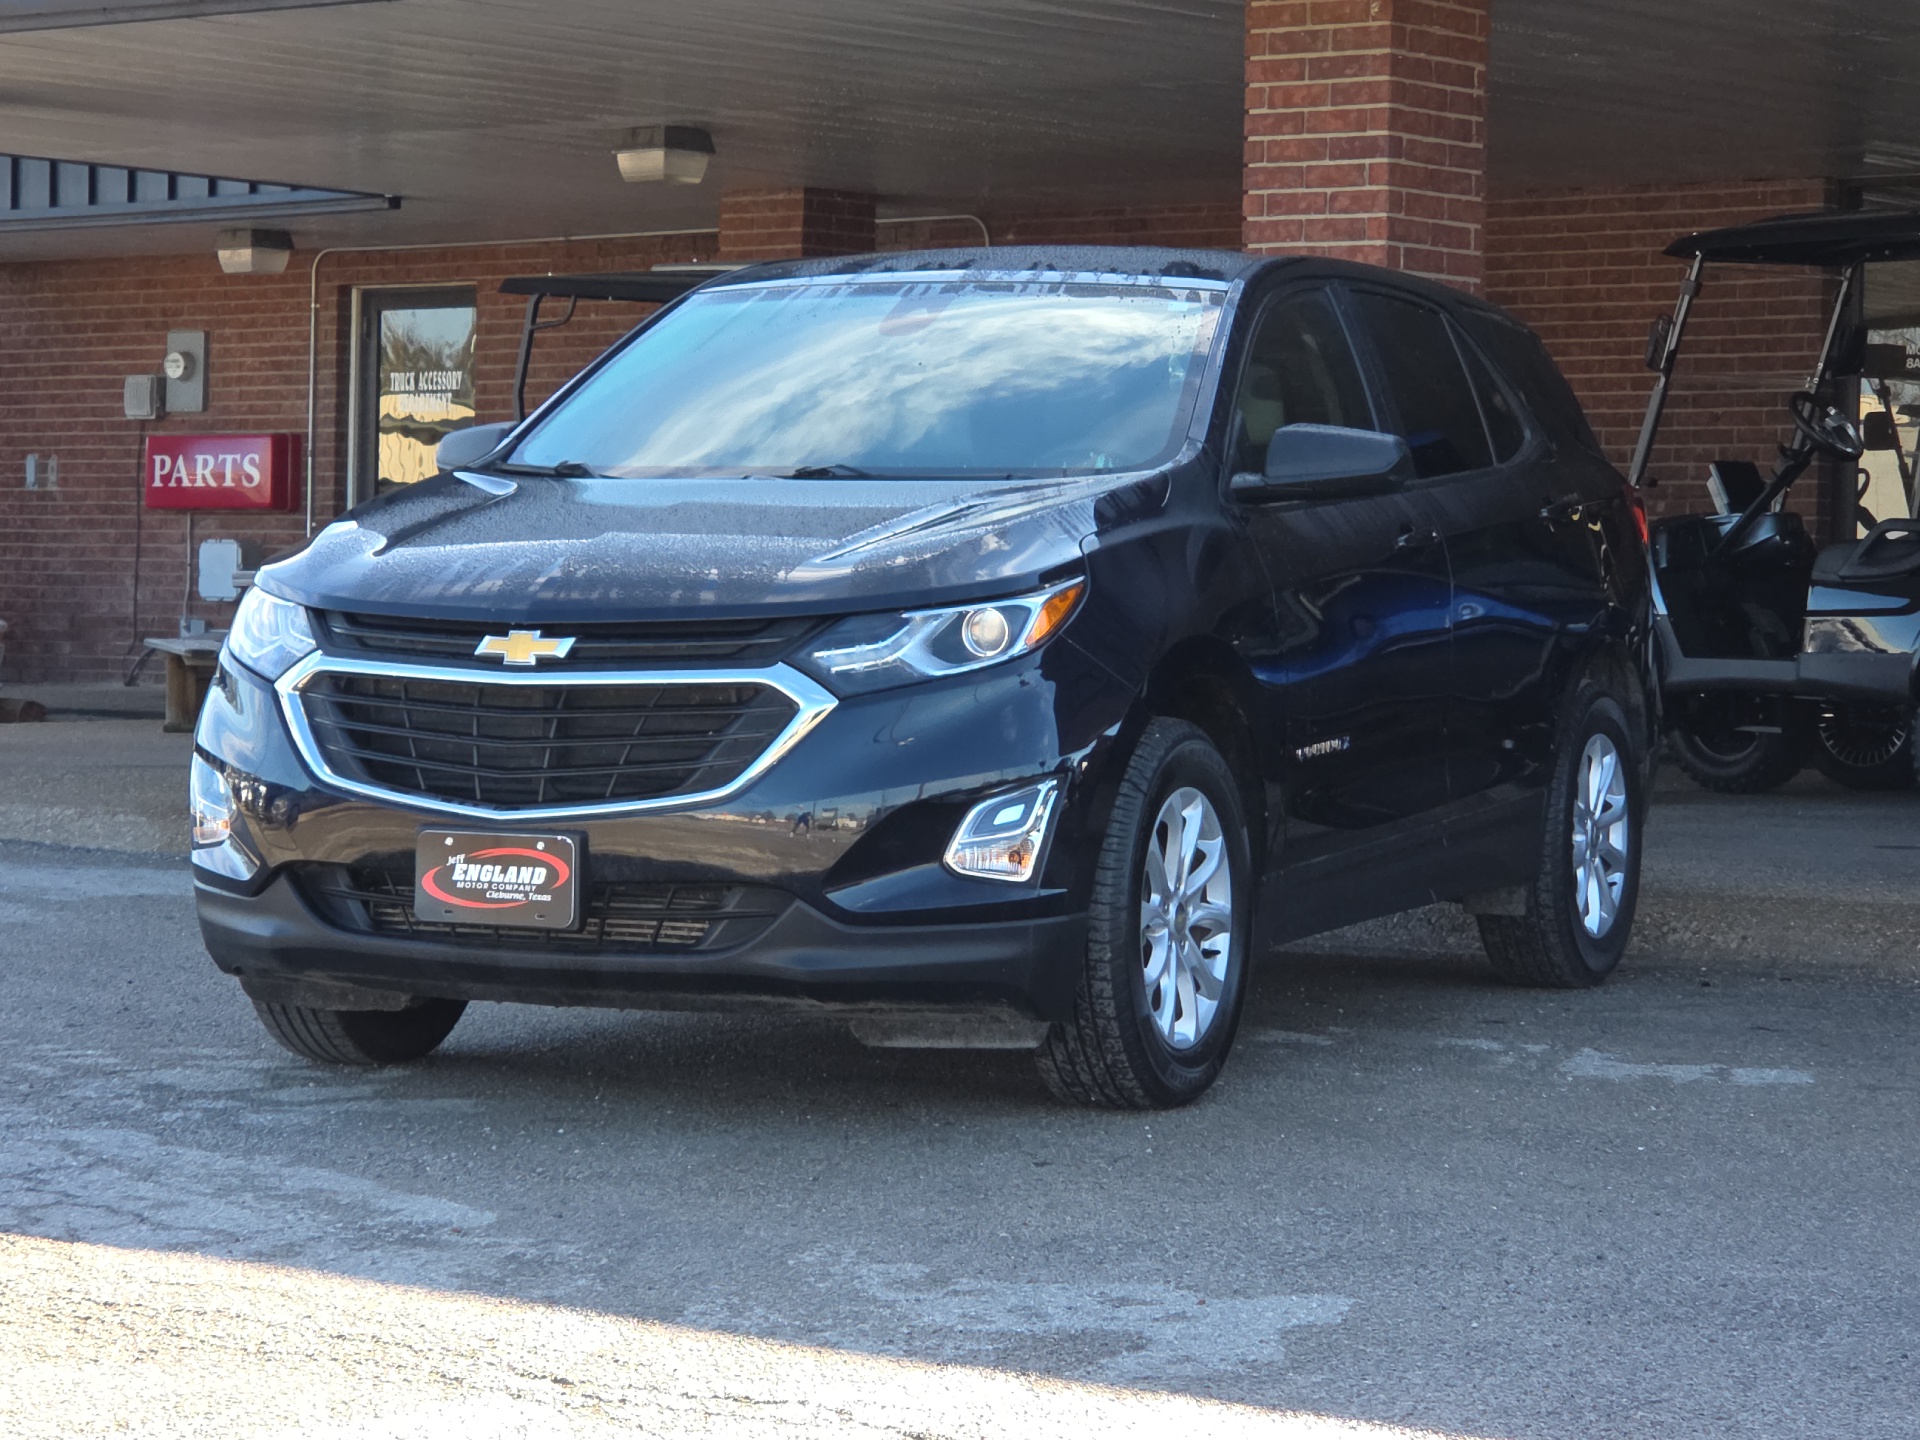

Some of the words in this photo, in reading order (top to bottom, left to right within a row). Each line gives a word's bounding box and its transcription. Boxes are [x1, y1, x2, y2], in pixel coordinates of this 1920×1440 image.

[390, 371, 415, 391] TRUCK
[418, 370, 463, 391] ACCESSORY
[152, 453, 261, 488] PARTS
[452, 863, 547, 885] ENGLAND
[456, 881, 488, 889] MOTOR
[491, 883, 537, 892] COMPANY
[486, 890, 526, 901] Cleburne,
[528, 892, 552, 902] Texas
